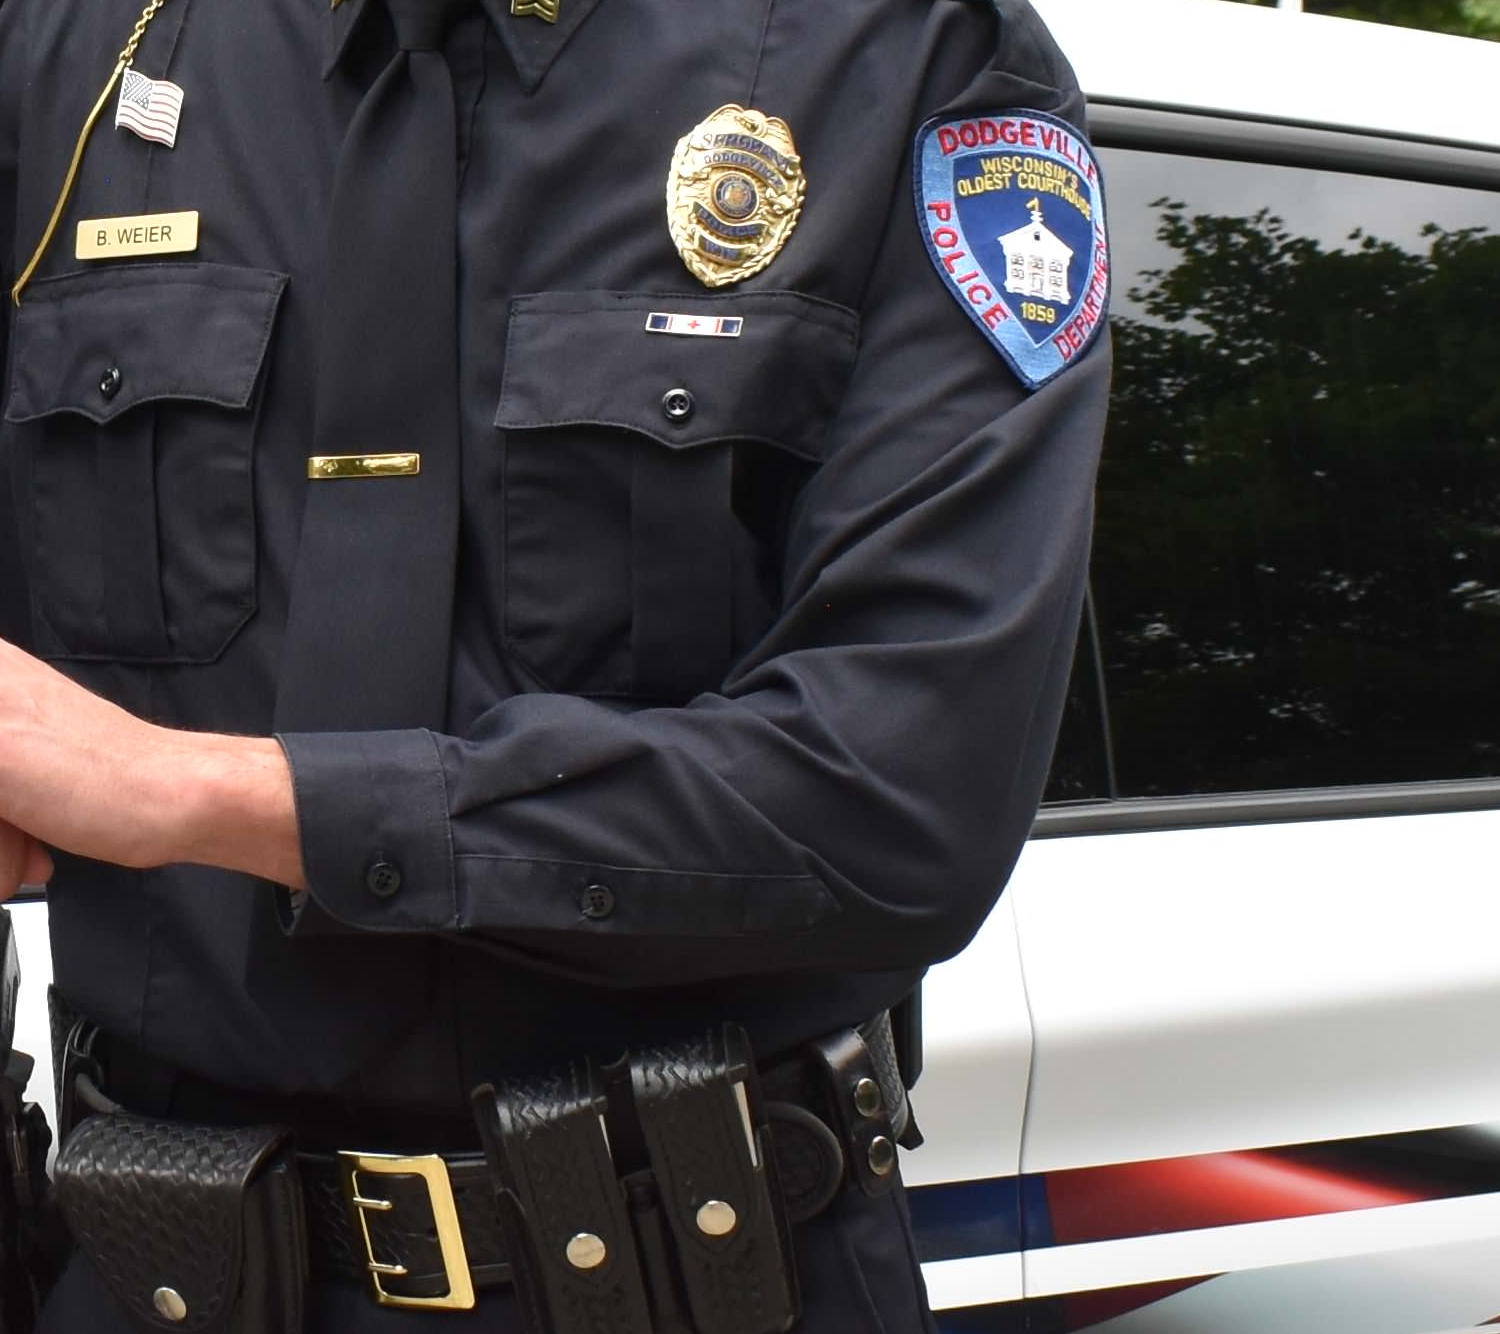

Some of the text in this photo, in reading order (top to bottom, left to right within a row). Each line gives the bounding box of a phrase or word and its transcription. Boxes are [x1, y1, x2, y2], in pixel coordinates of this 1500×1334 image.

[937, 119, 1098, 183] DODGEVILLE
[980, 155, 1078, 189] WISCONSIN'S
[957, 172, 1093, 221] OLDEST COURTHOUSE
[96, 225, 173, 247] B. WEIER
[927, 201, 1010, 331] POLICE
[1053, 223, 1108, 364] DEPARTMENT
